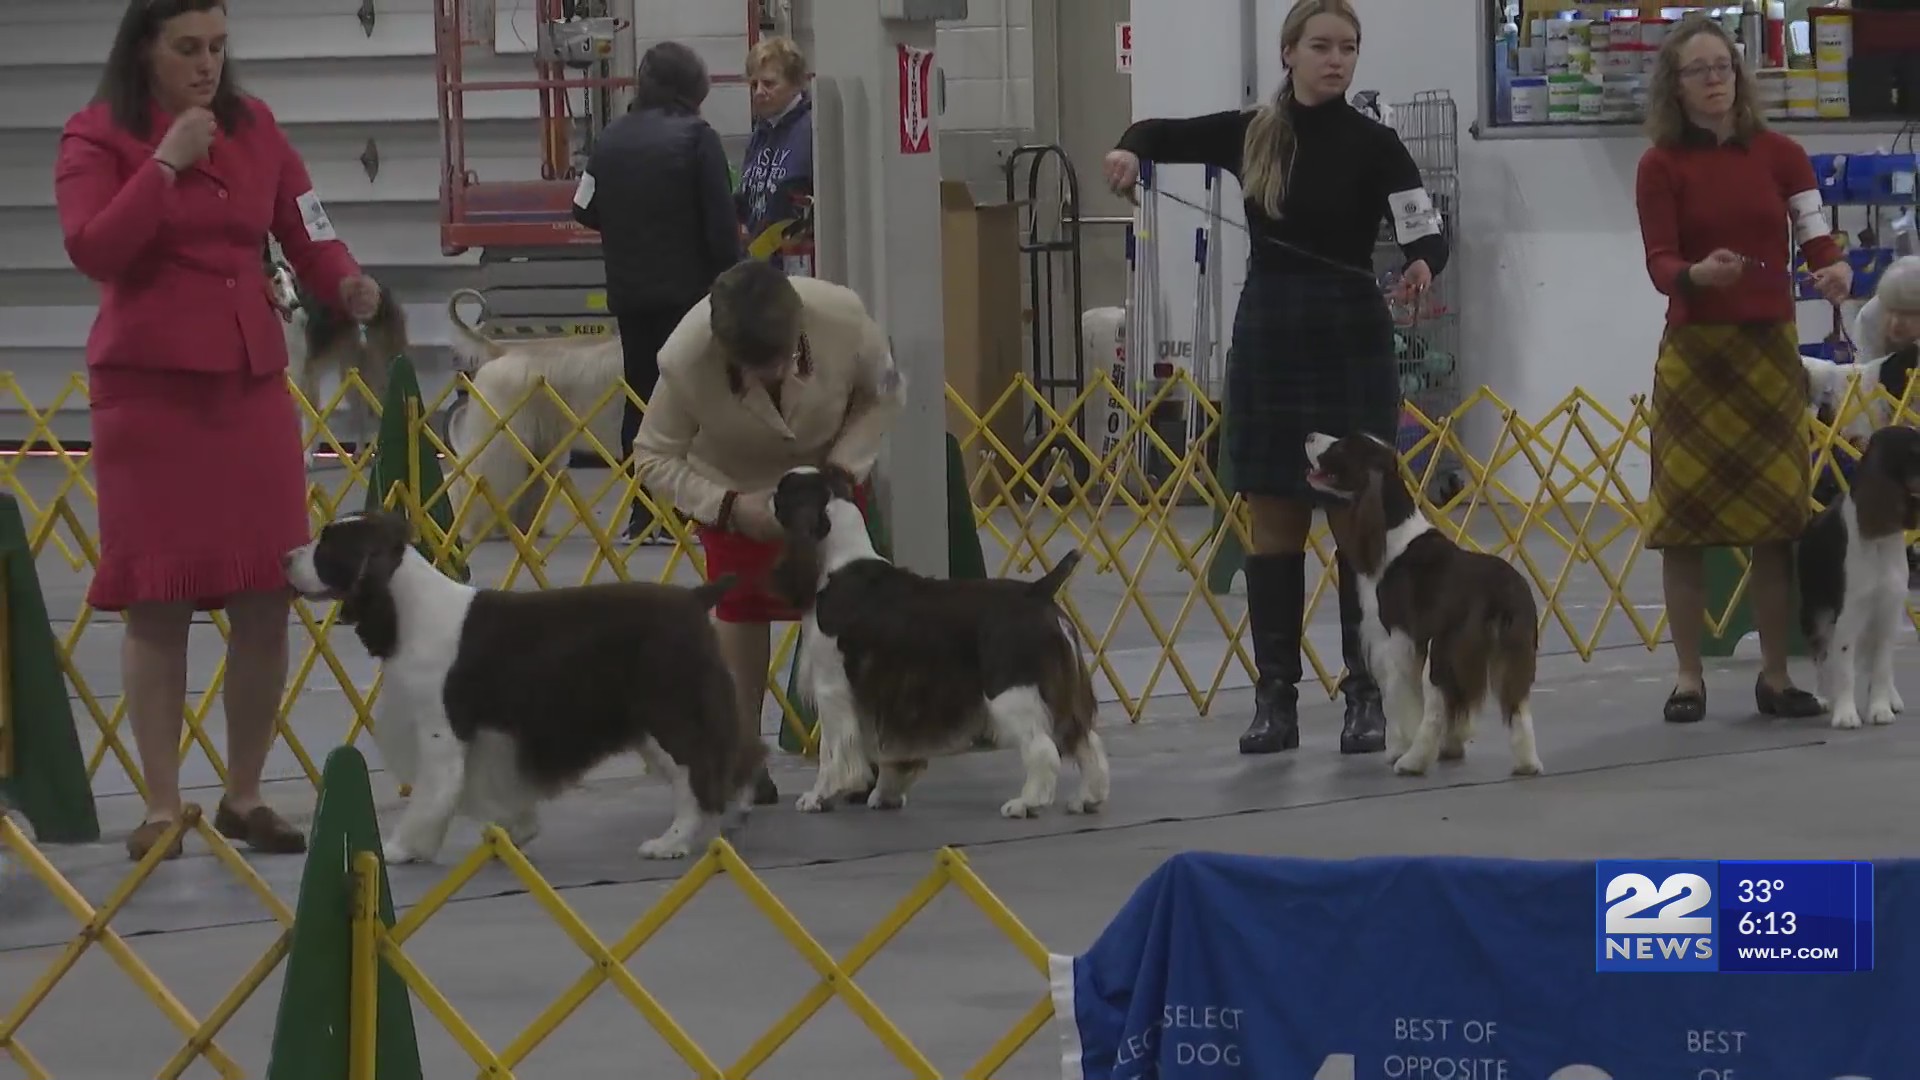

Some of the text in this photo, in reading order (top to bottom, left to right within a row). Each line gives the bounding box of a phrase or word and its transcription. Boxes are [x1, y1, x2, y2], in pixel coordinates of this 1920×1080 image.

[574, 324, 605, 334] KEEP
[1159, 341, 1218, 359] QUET
[1163, 1005, 1244, 1030] SELECT
[1395, 1017, 1497, 1043] BEST OF
[1687, 1030, 1746, 1053] BEST
[1177, 1043, 1241, 1066] DOG
[1384, 1055, 1509, 1080] OPPOSITE
